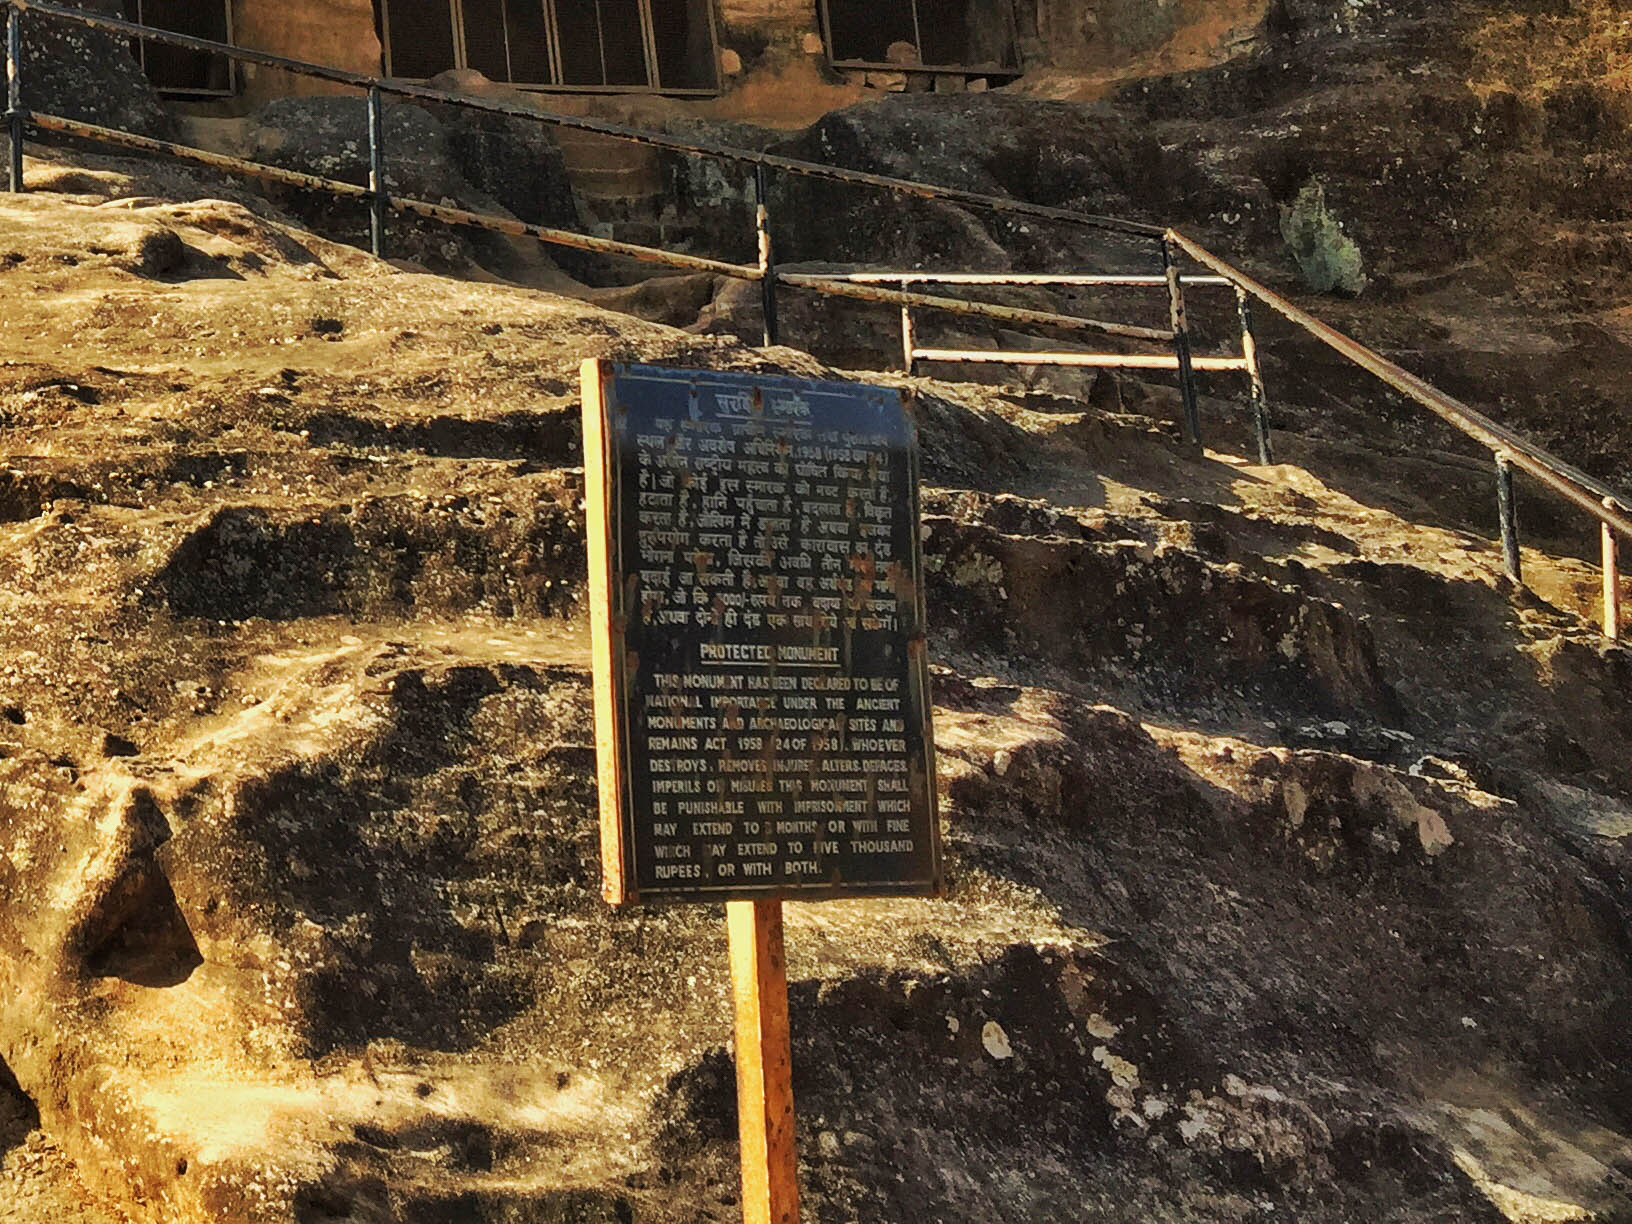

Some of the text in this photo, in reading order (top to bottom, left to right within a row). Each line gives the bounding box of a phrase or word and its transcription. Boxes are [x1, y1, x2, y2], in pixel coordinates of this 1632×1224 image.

[778, 646, 840, 661] MONUMENT
[653, 674, 680, 688] THIS
[683, 674, 744, 689] MONUMNT
[748, 676, 769, 689] HAS
[773, 676, 797, 690] BEEN
[854, 678, 868, 691] TO
[870, 679, 883, 691] BE
[885, 679, 900, 691] OF
[784, 697, 817, 710] UNDER
[826, 698, 845, 710] THE
[856, 698, 900, 711] ANCIENT
[723, 717, 744, 729] AD
[849, 718, 876, 732] SITES
[648, 738, 698, 750] REMAINS
[705, 738, 727, 750] ACT
[738, 738, 763, 750] 1958
[792, 739, 806, 751] OF
[852, 738, 906, 752] WHOEVER
[652, 780, 701, 793] IMPERILS
[878, 780, 909, 792] SHALL
[653, 802, 668, 815] BE
[678, 801, 745, 814] PUNISHABLE
[757, 801, 783, 814] WITH
[877, 800, 911, 813] WHICH
[654, 823, 677, 836] MAY
[693, 822, 733, 836] EXTEND
[744, 822, 760, 834] TO
[828, 821, 845, 833] OR
[853, 821, 878, 833] WITH
[887, 820, 910, 832] FINE
[704, 844, 726, 857] AY
[738, 843, 777, 856] EXTEND
[788, 842, 803, 853] TO
[850, 841, 913, 853] THOUSAND
[718, 864, 735, 876] OR
[743, 863, 772, 876] WITH
